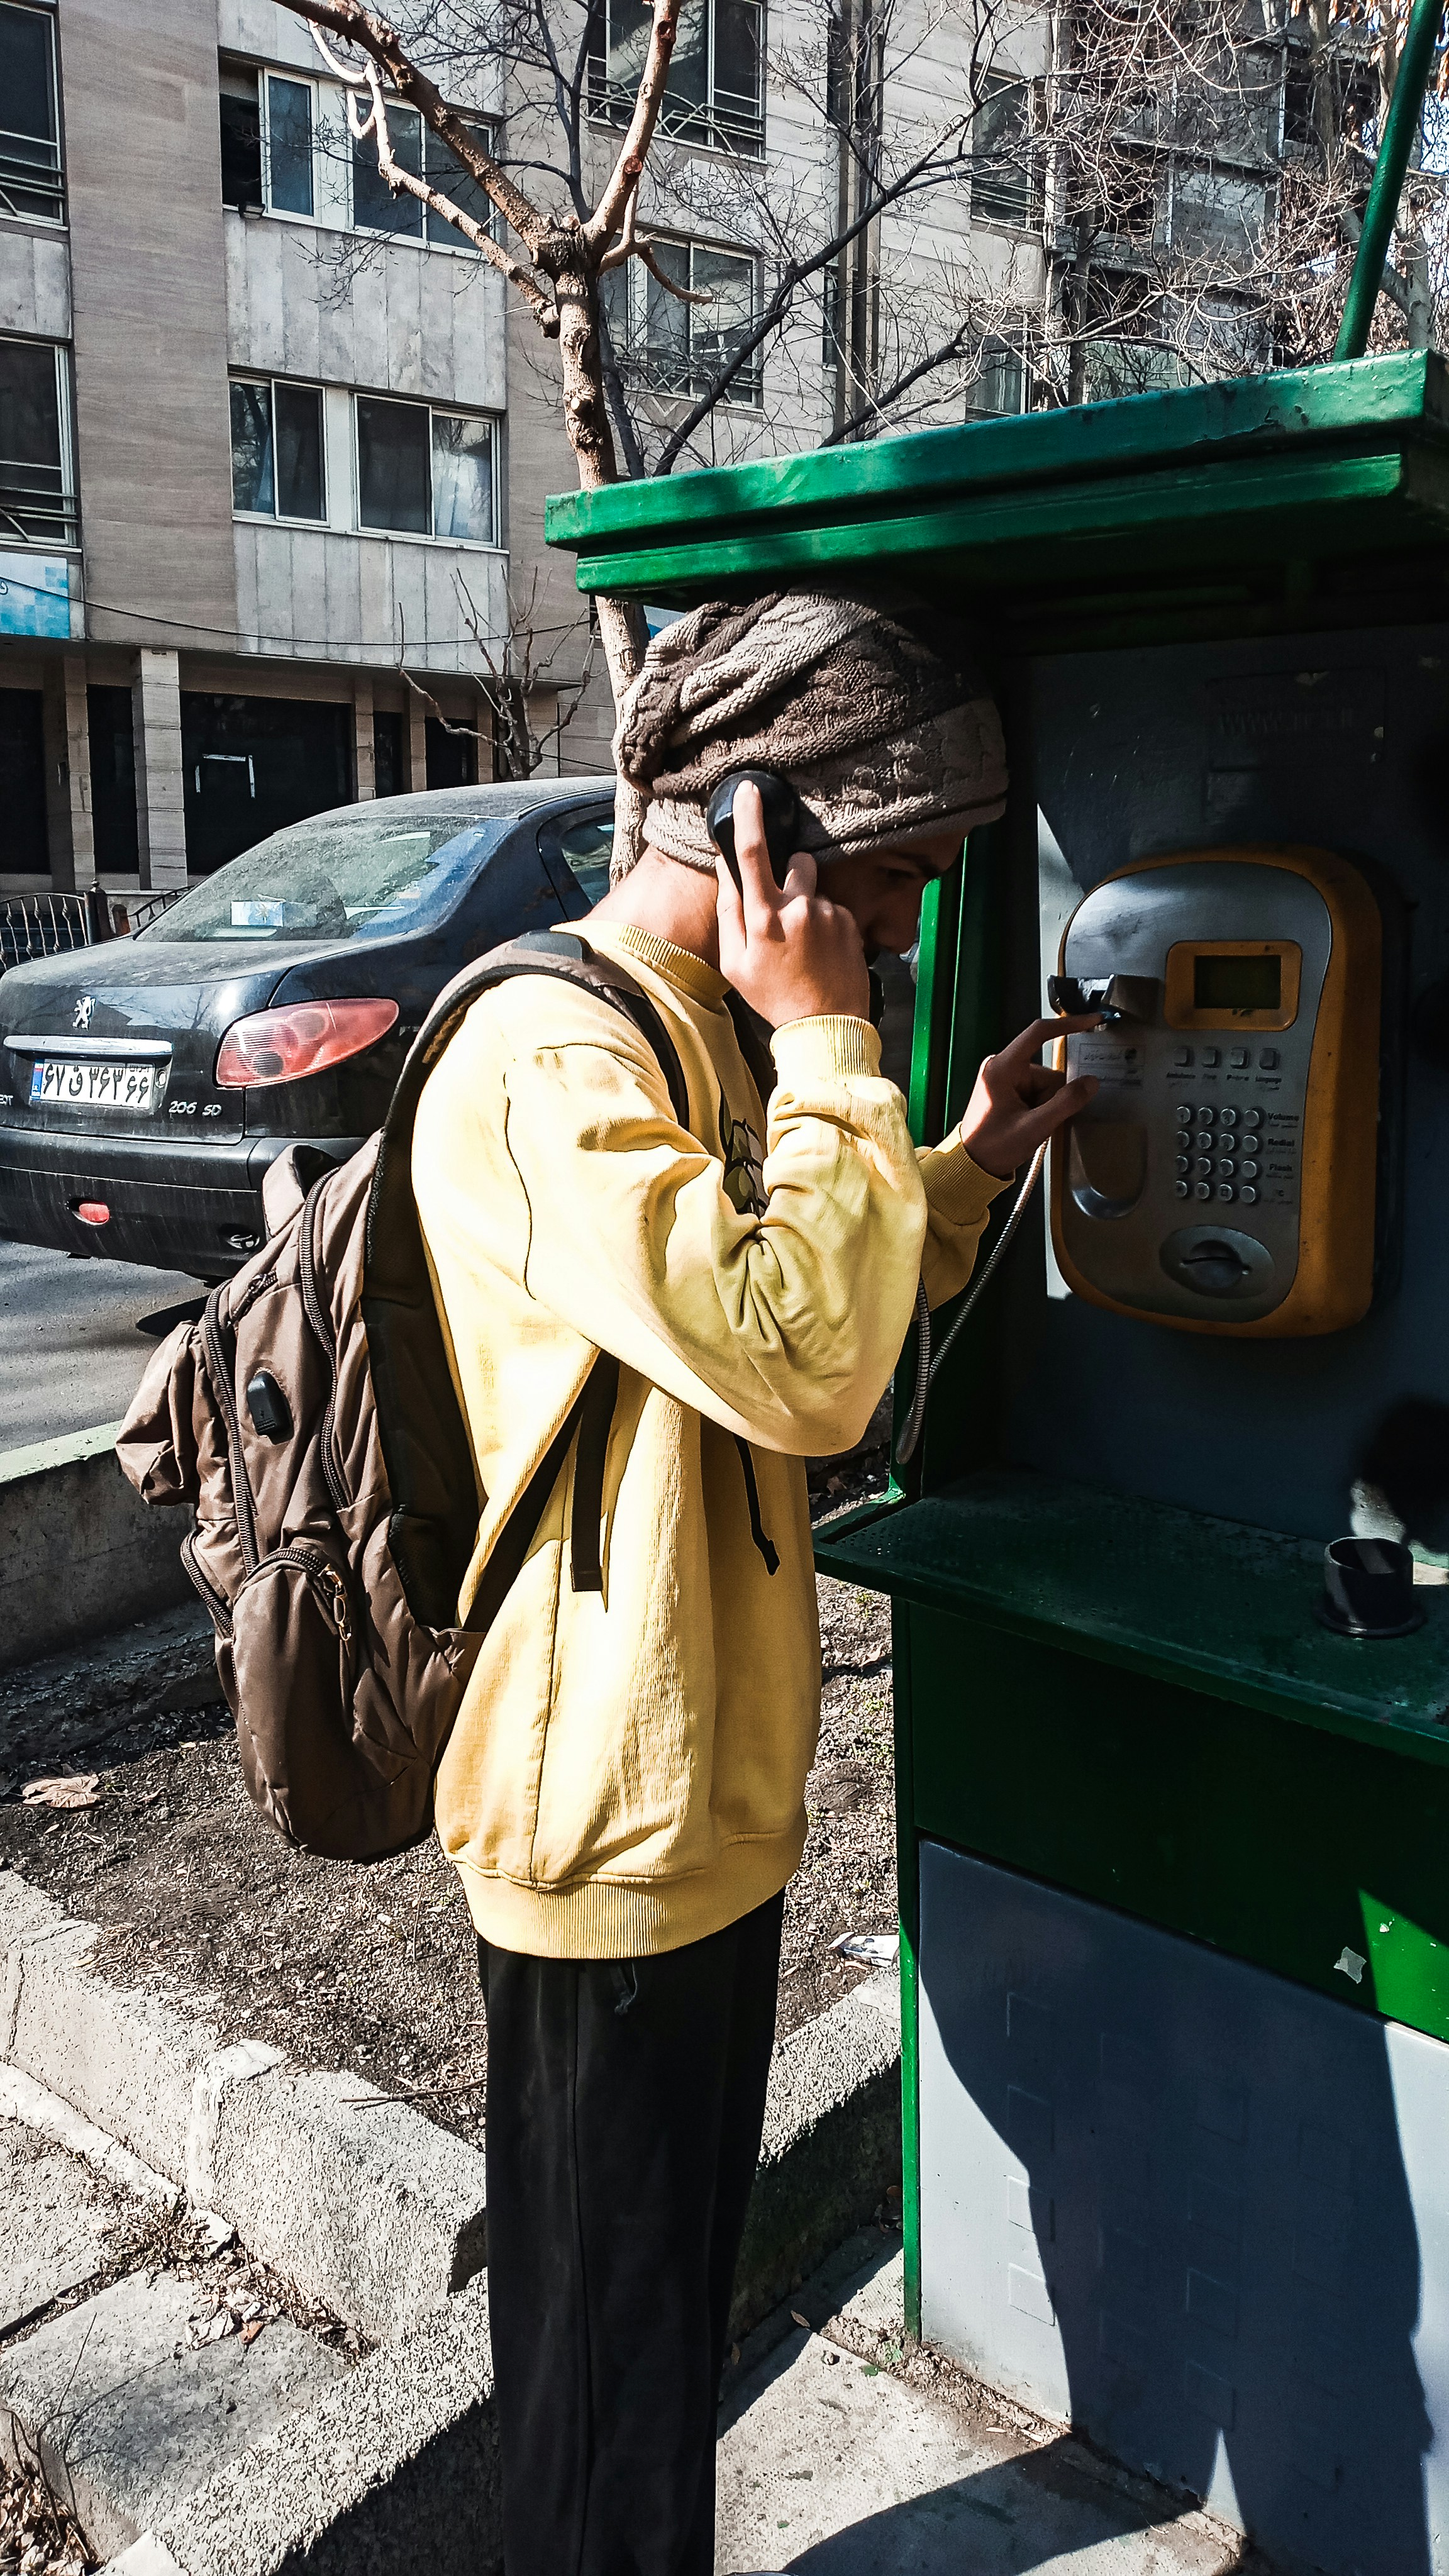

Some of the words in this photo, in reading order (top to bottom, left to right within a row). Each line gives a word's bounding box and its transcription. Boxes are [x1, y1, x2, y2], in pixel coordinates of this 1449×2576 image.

[89, 1067, 124, 1101] ۳۶۳
[125, 1075, 149, 1104] ۶۶
[169, 1101, 197, 1114] 206
[202, 1104, 222, 1116] SD
[1267, 1113, 1299, 1121] Volume
[1267, 1138, 1295, 1146] Redial
[1269, 1163, 1292, 1172] Flash
